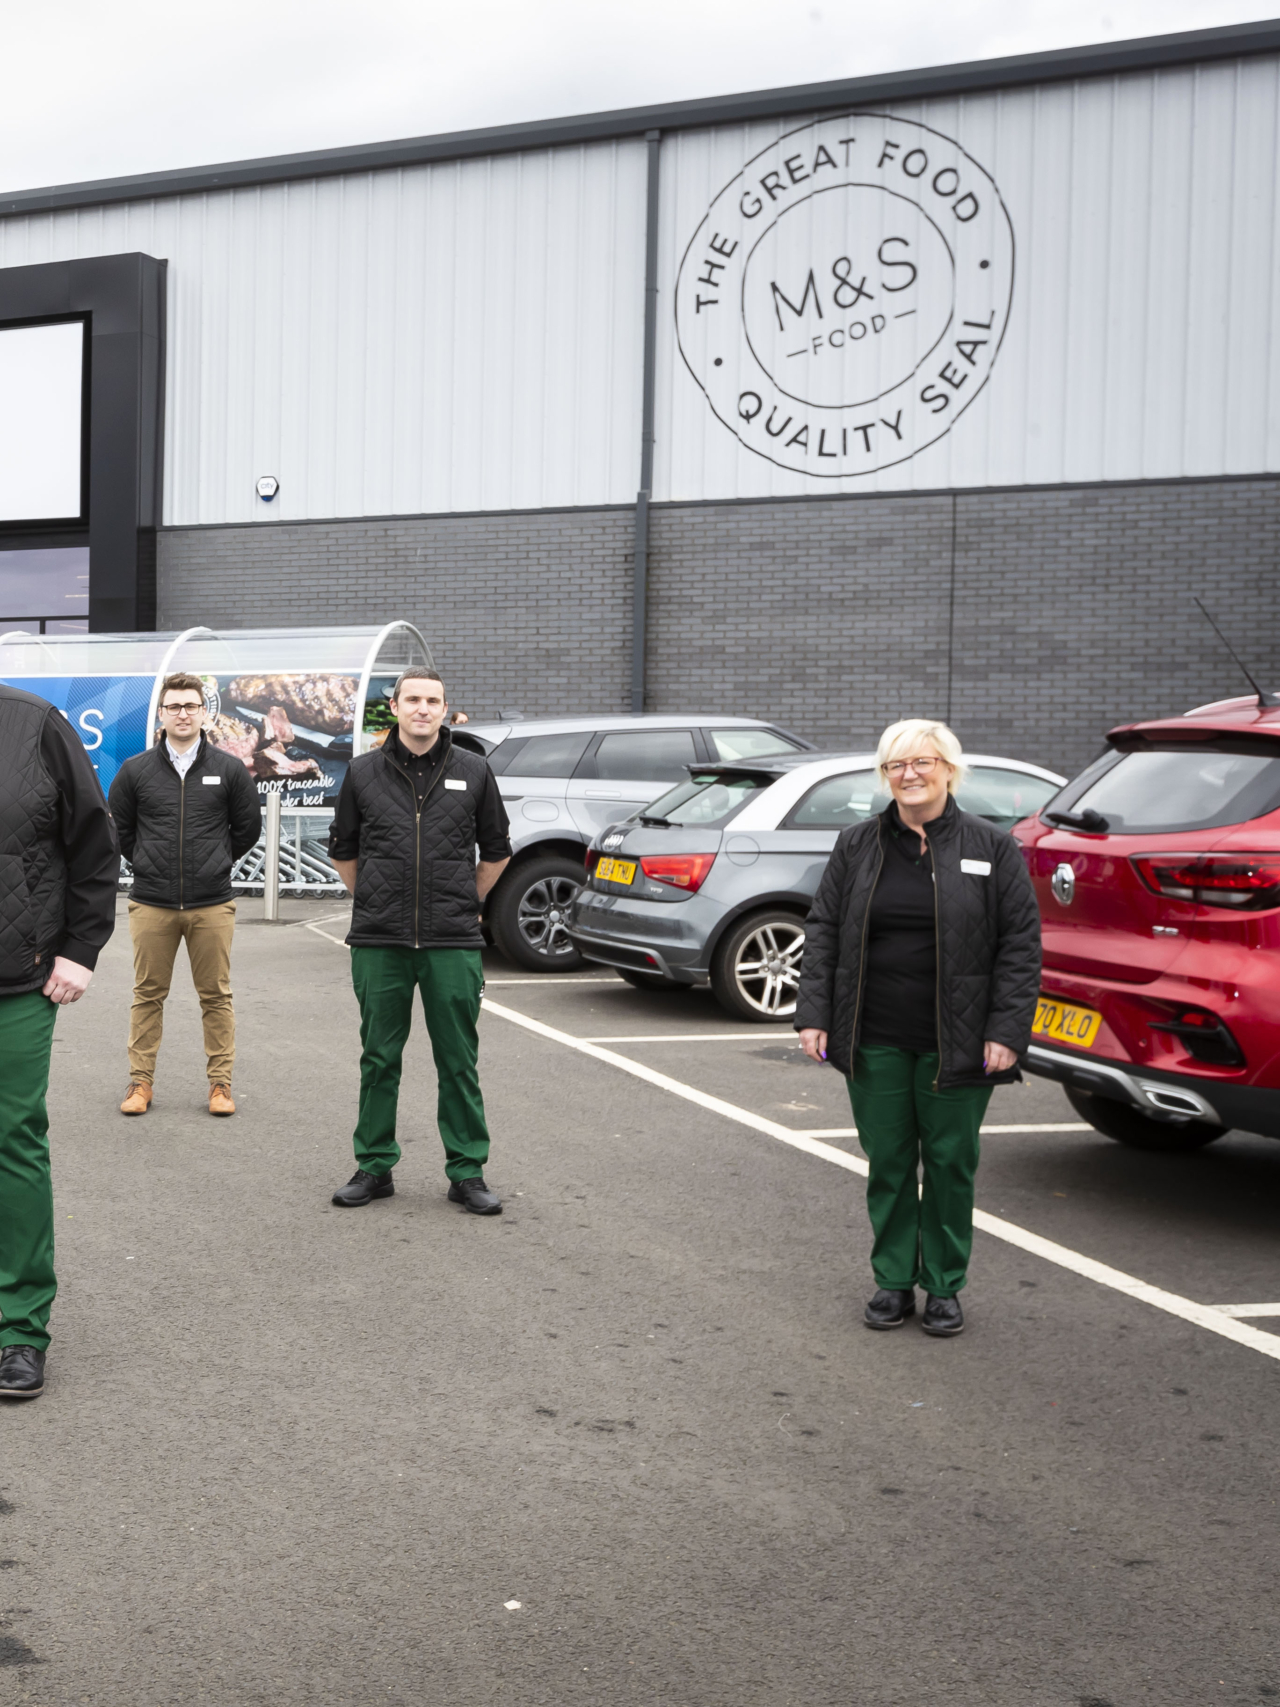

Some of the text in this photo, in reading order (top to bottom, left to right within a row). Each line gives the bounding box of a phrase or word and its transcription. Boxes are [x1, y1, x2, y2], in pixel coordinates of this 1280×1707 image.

[696, 138, 980, 314] THE GREAT FOOD
[770, 236, 917, 332] M&S
[811, 314, 887, 355] FOOD
[737, 310, 996, 457] QUALITY SEAL
[257, 775, 335, 794] 100% traceable
[303, 791, 324, 806] beef
[1033, 1002, 1093, 1039] 70 XLO
